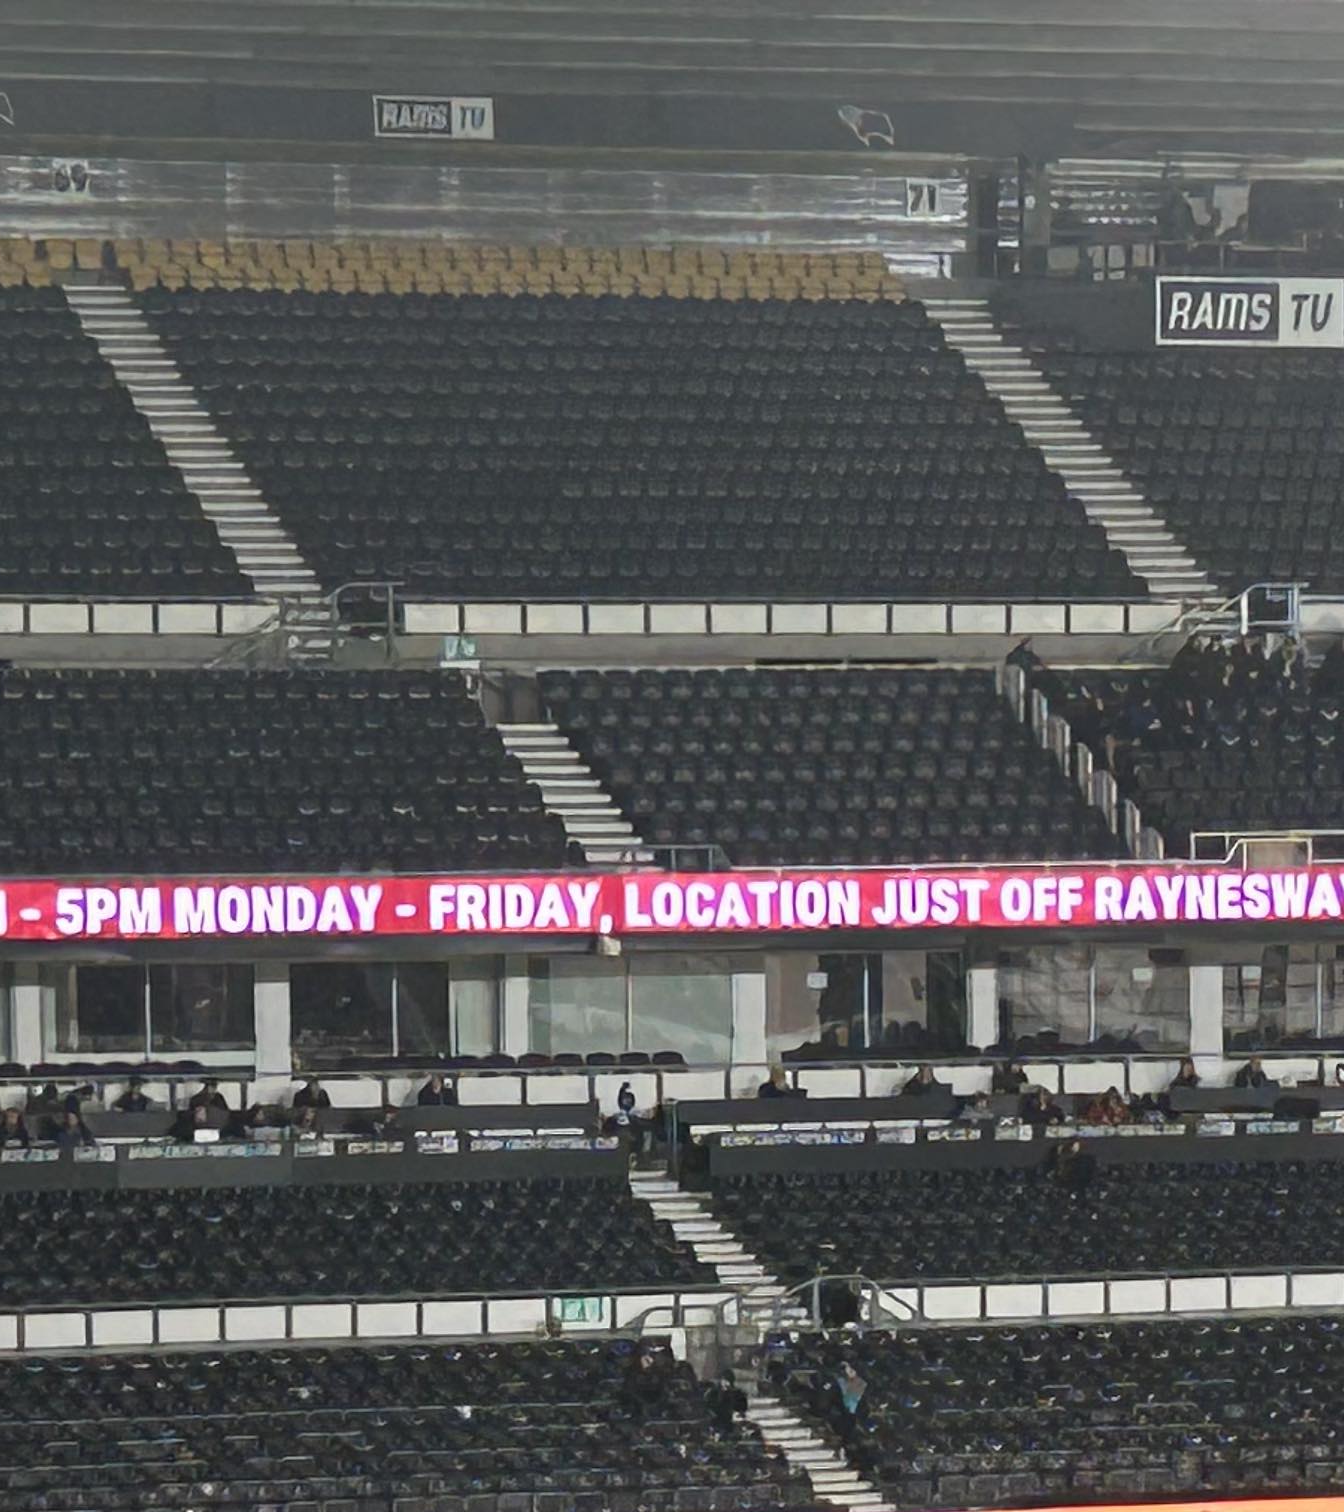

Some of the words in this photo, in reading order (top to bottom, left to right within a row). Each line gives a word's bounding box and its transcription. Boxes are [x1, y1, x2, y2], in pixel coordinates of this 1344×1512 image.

[1168, 290, 1272, 332] RAMS
[55, 887, 162, 935] 5PM
[174, 884, 382, 934] MONDAY
[428, 883, 612, 934] FRIDAY,
[625, 879, 857, 930] LOCATION
[872, 877, 989, 925] JUST
[1002, 876, 1084, 922] OFF
